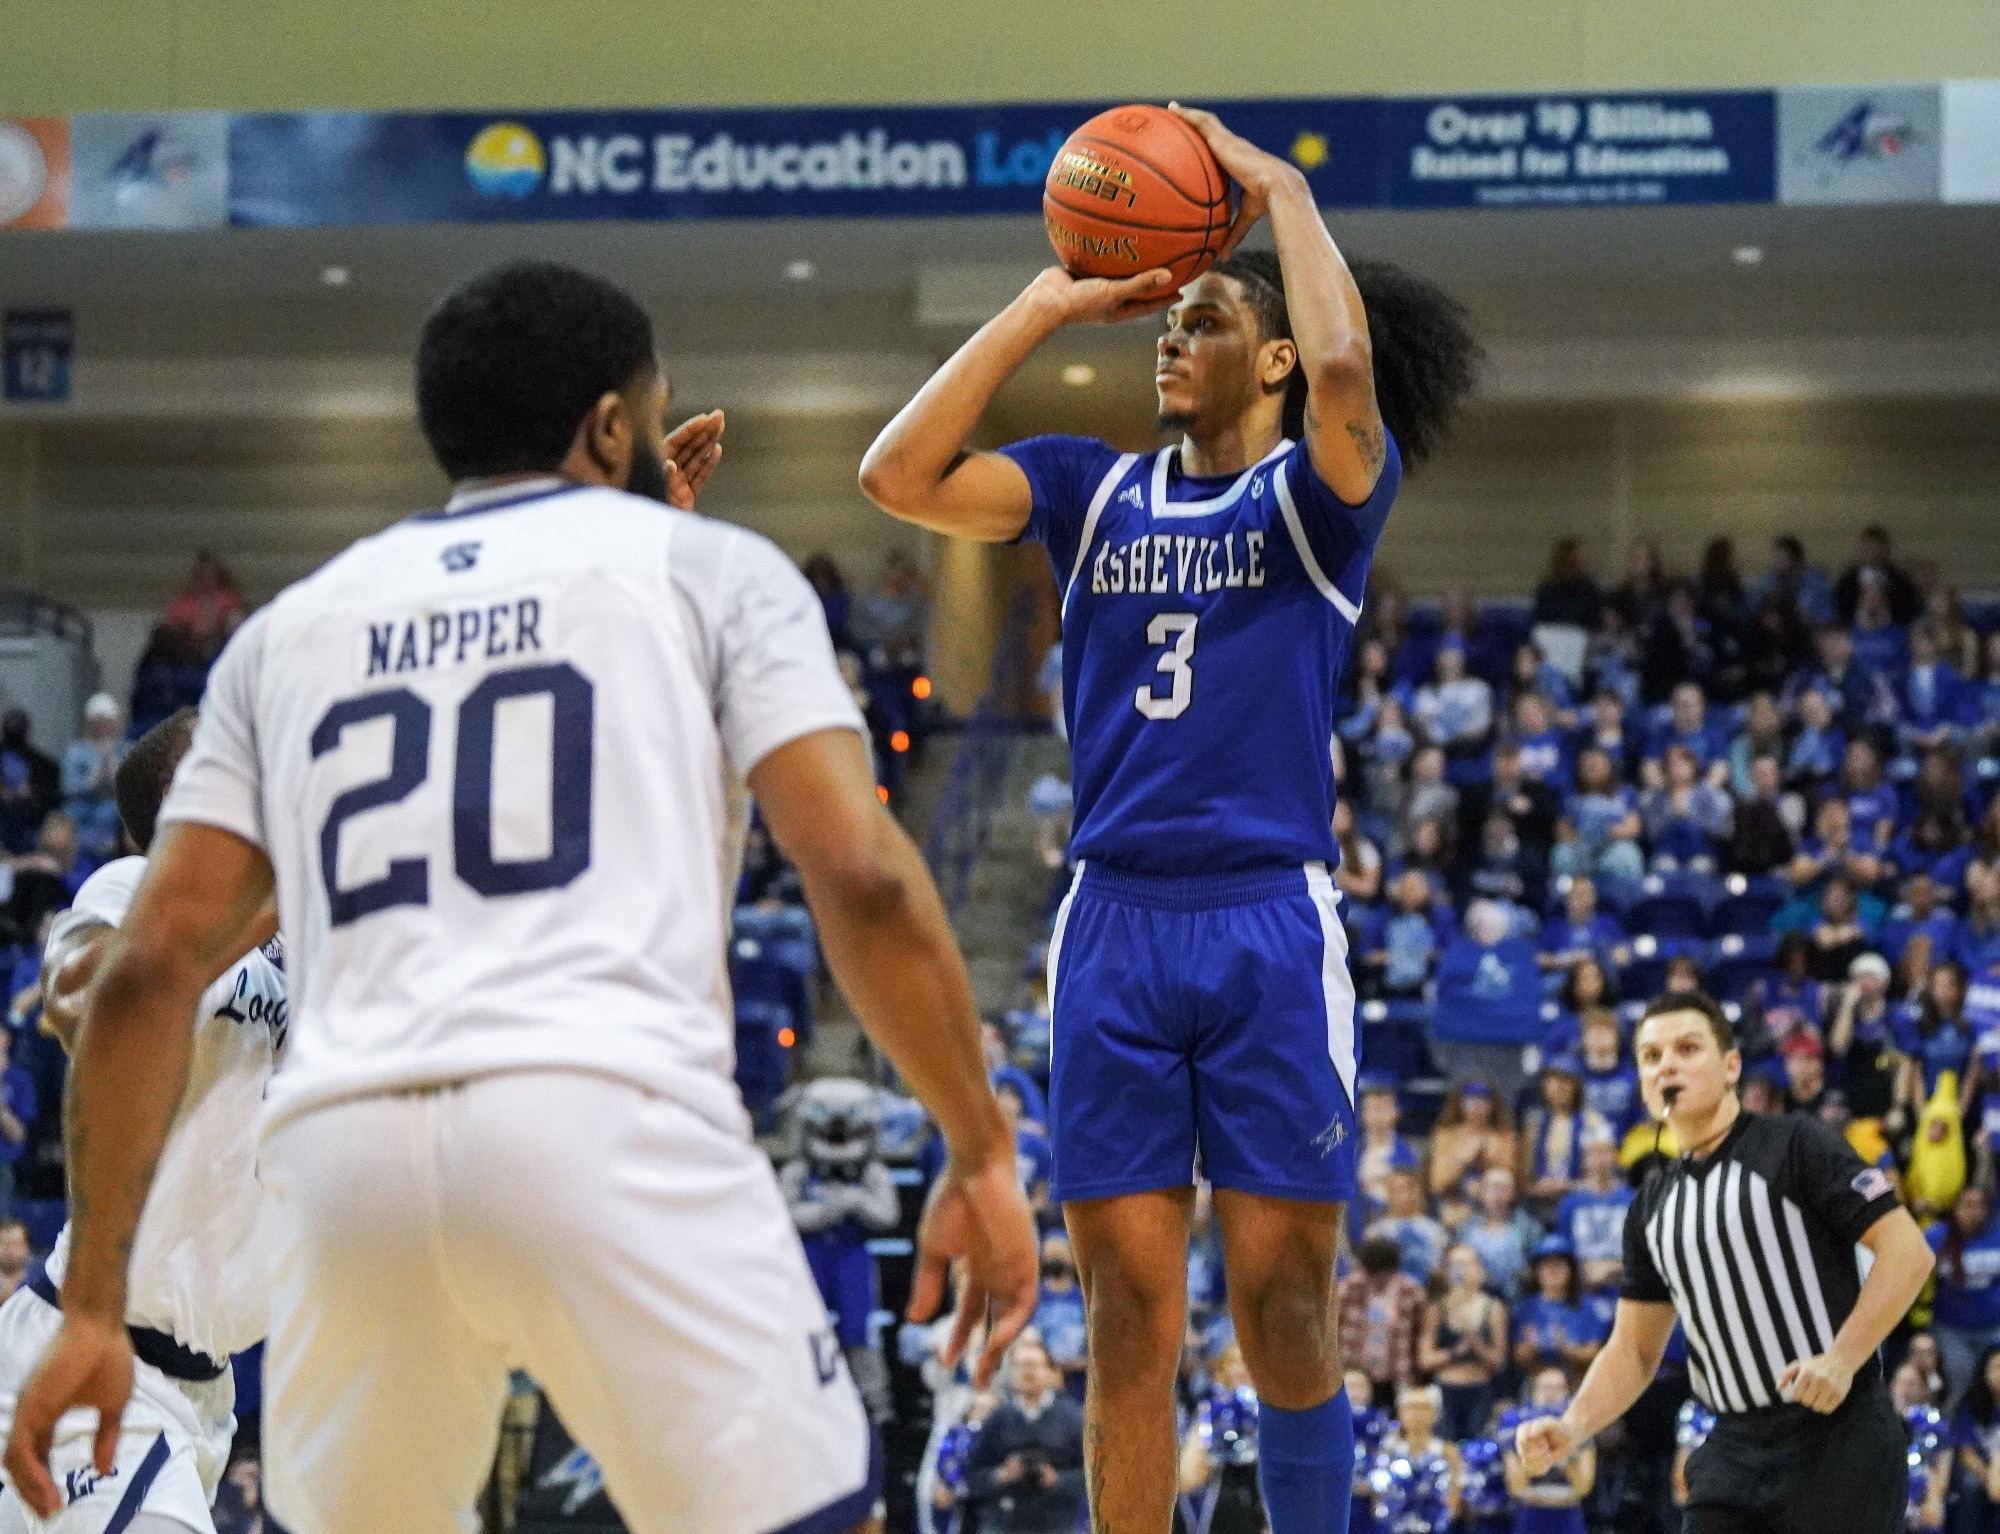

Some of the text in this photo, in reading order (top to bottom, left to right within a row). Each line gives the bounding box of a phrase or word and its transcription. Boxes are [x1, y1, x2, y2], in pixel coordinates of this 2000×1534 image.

[550, 136, 643, 193] NC
[652, 127, 967, 192] Education
[1091, 530, 1266, 594] ASHEVILLE
[366, 597, 543, 678] NAPPER
[1134, 612, 1198, 720] 3
[310, 660, 595, 929] 20
